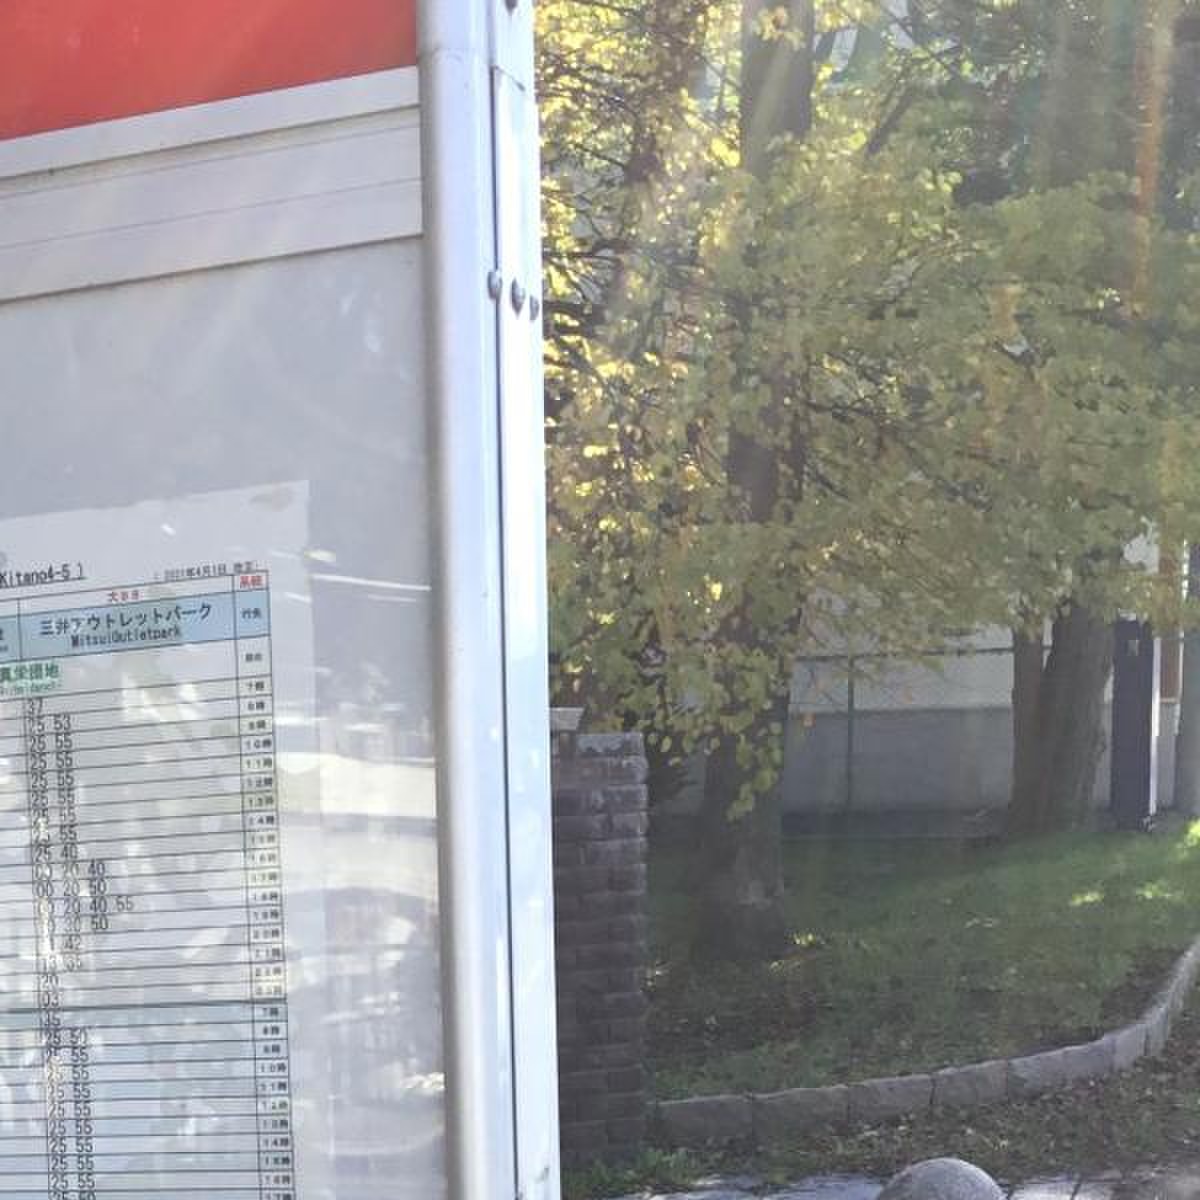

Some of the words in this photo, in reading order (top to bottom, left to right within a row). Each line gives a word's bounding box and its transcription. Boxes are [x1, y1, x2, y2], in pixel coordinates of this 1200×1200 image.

[39, 603, 212, 637] 三井アウトレットパーク
